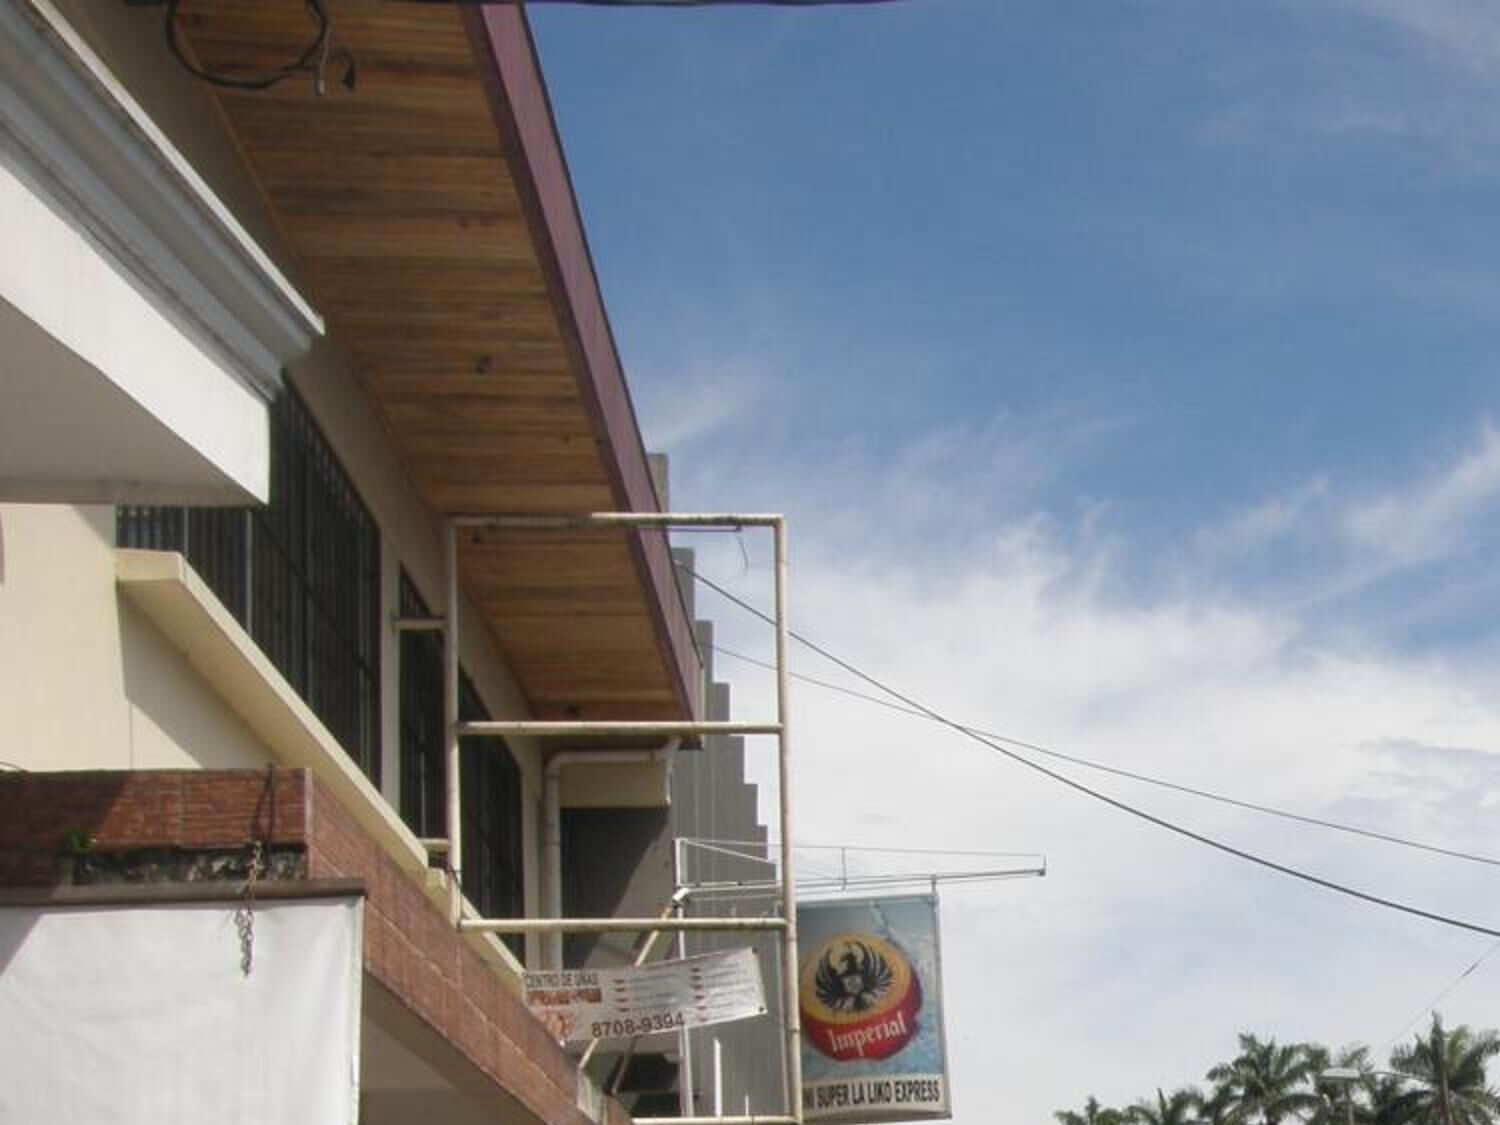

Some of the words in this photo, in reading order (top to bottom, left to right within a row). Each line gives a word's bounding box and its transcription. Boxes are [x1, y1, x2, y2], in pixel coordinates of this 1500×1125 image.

[591, 1011, 686, 1038] 8708-9394
[826, 1010, 908, 1057] Imperial
[816, 1083, 849, 1108] SUPER
[851, 1081, 865, 1105] LA
[867, 1080, 893, 1104] LIKO
[895, 1078, 941, 1103] EXPRESS
